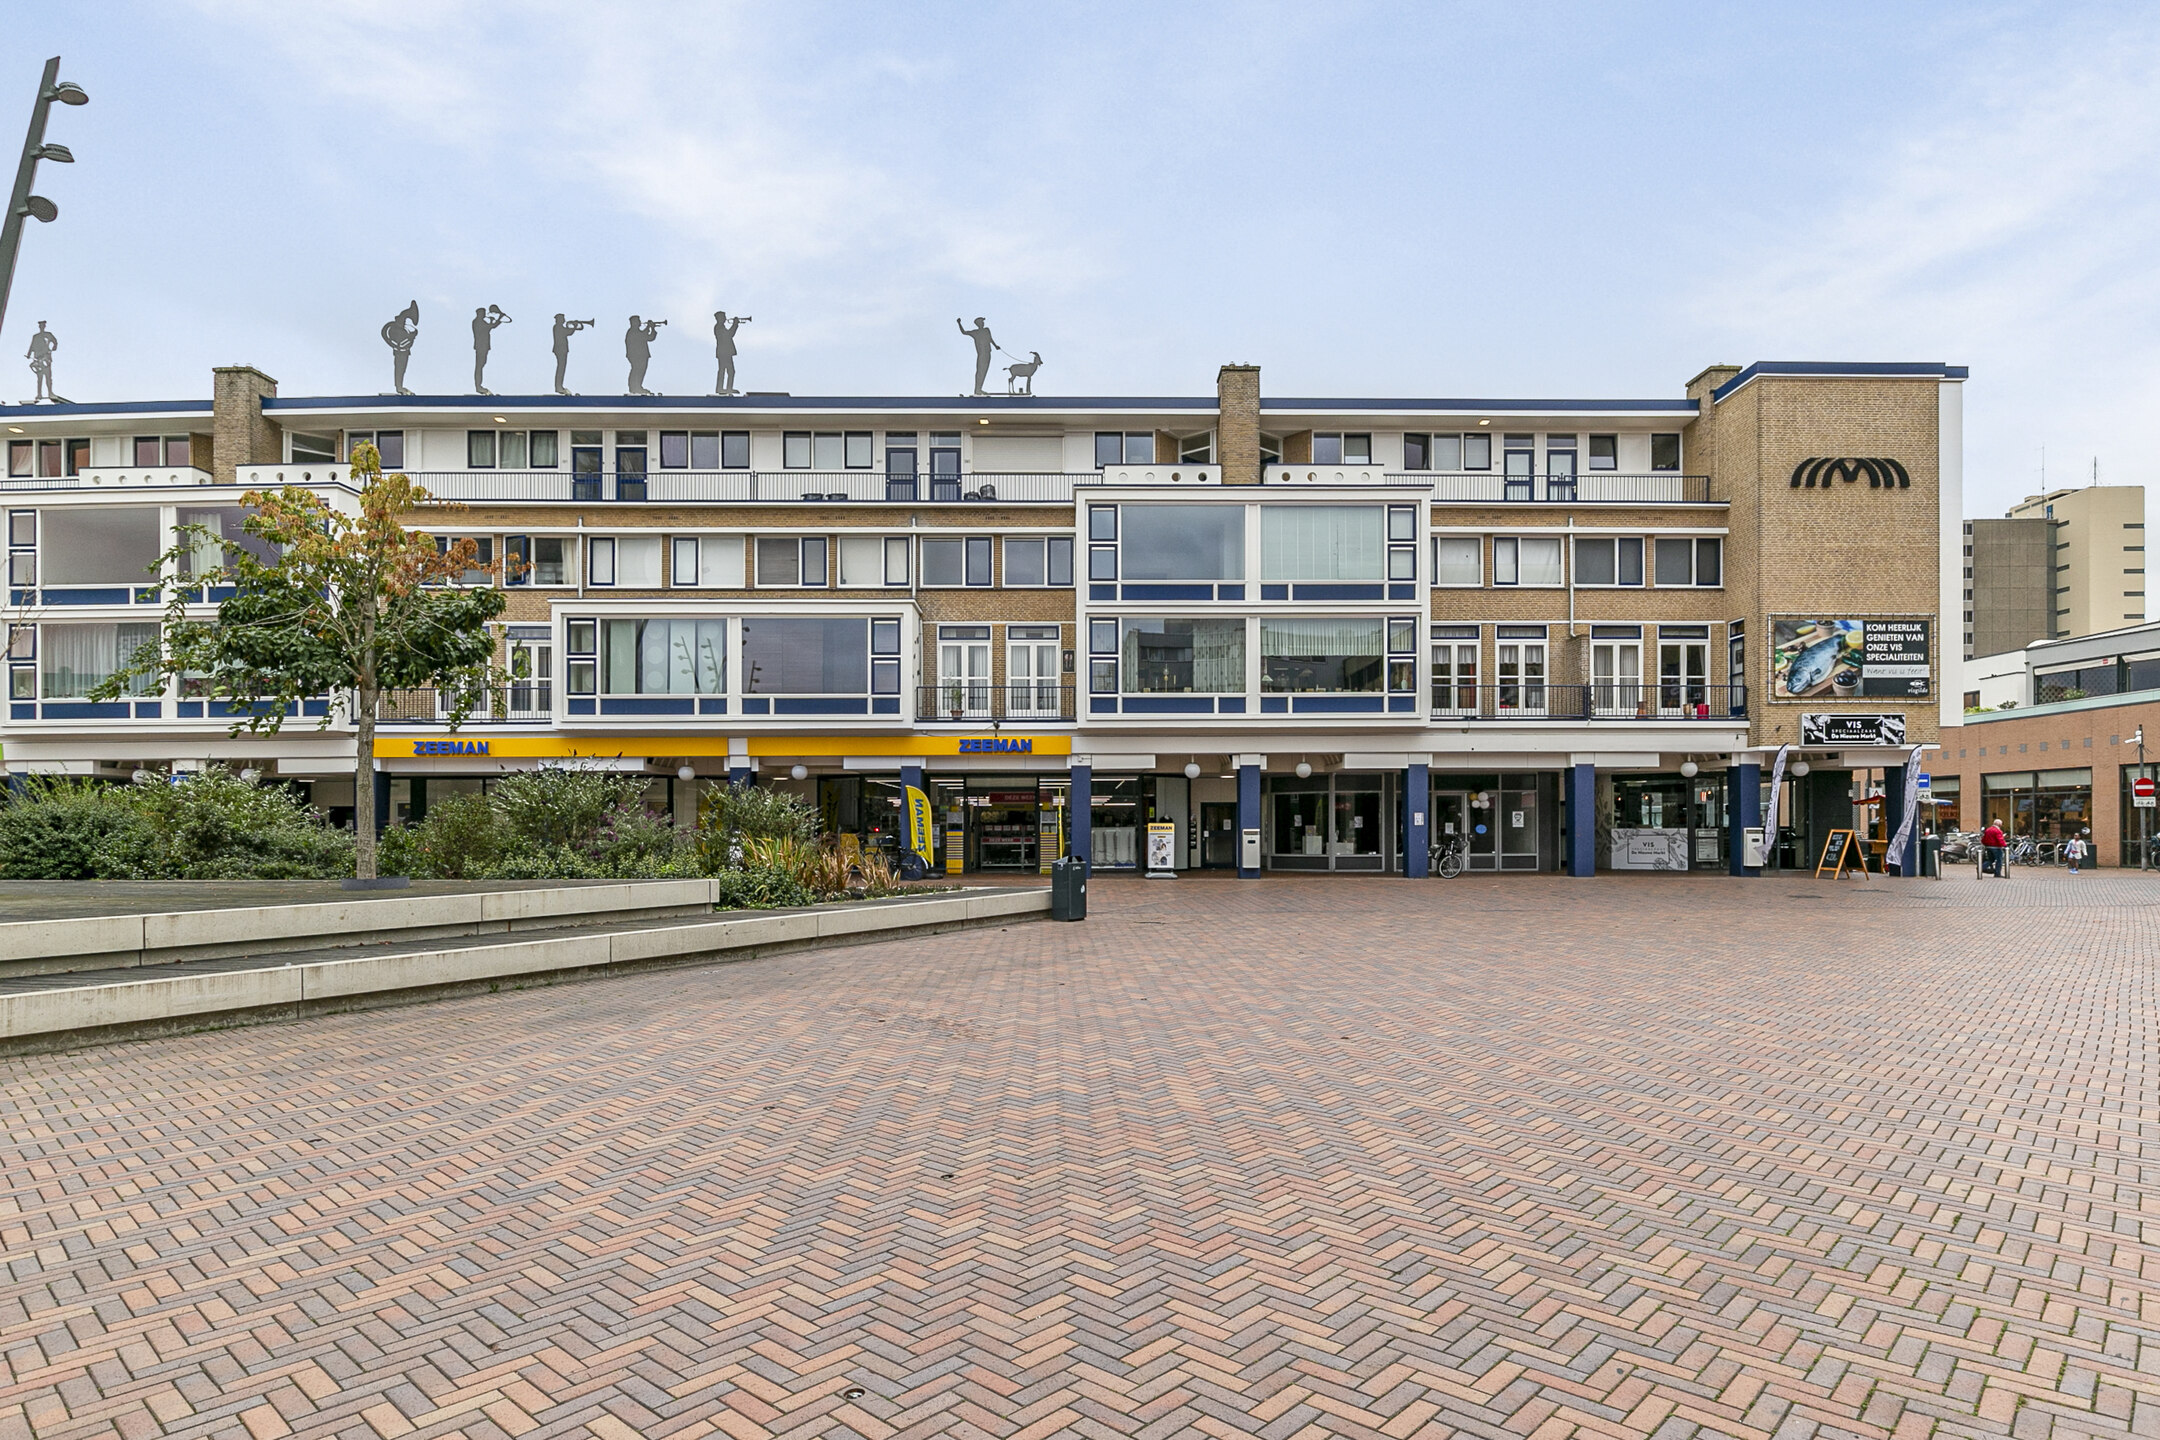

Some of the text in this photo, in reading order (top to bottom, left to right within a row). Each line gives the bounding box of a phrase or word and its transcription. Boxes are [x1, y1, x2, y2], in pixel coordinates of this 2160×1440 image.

[1866, 623, 1922, 632] KOM HEERLIJK
[1866, 633, 1924, 641] GENIETEN VAN
[1866, 643, 1903, 651] ONZE VIS
[1866, 653, 1924, 661] SPECIALITEITEN
[1846, 720, 1862, 729] VIS
[413, 741, 489, 754] ZEEMAN
[959, 739, 1032, 752] ZEEMAN
